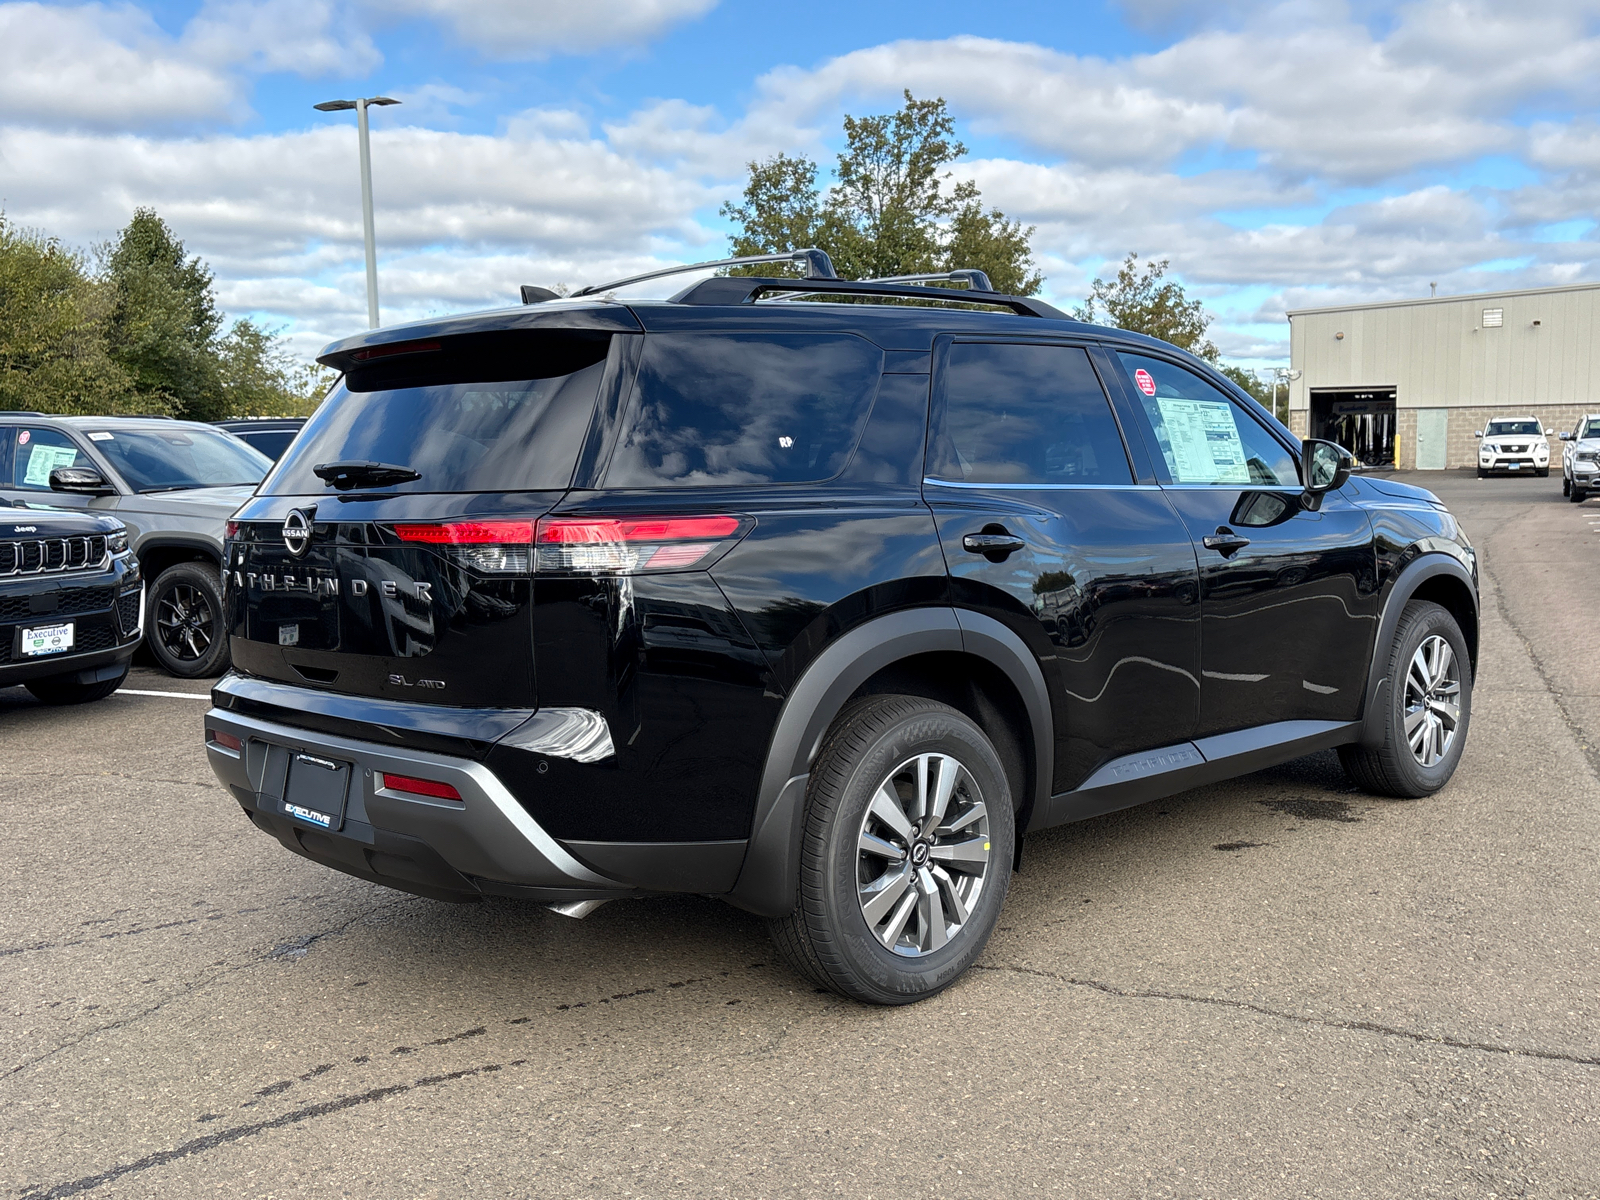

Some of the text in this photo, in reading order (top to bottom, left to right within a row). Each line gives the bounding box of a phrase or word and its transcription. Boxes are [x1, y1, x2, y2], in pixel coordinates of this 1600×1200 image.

[14, 525, 37, 533] Jeep
[282, 529, 308, 537] NSSAN
[222, 569, 433, 600] PATHFINDER
[27, 628, 68, 640] Executive
[389, 674, 414, 687] SL
[285, 803, 331, 825] EXECUTIVE
